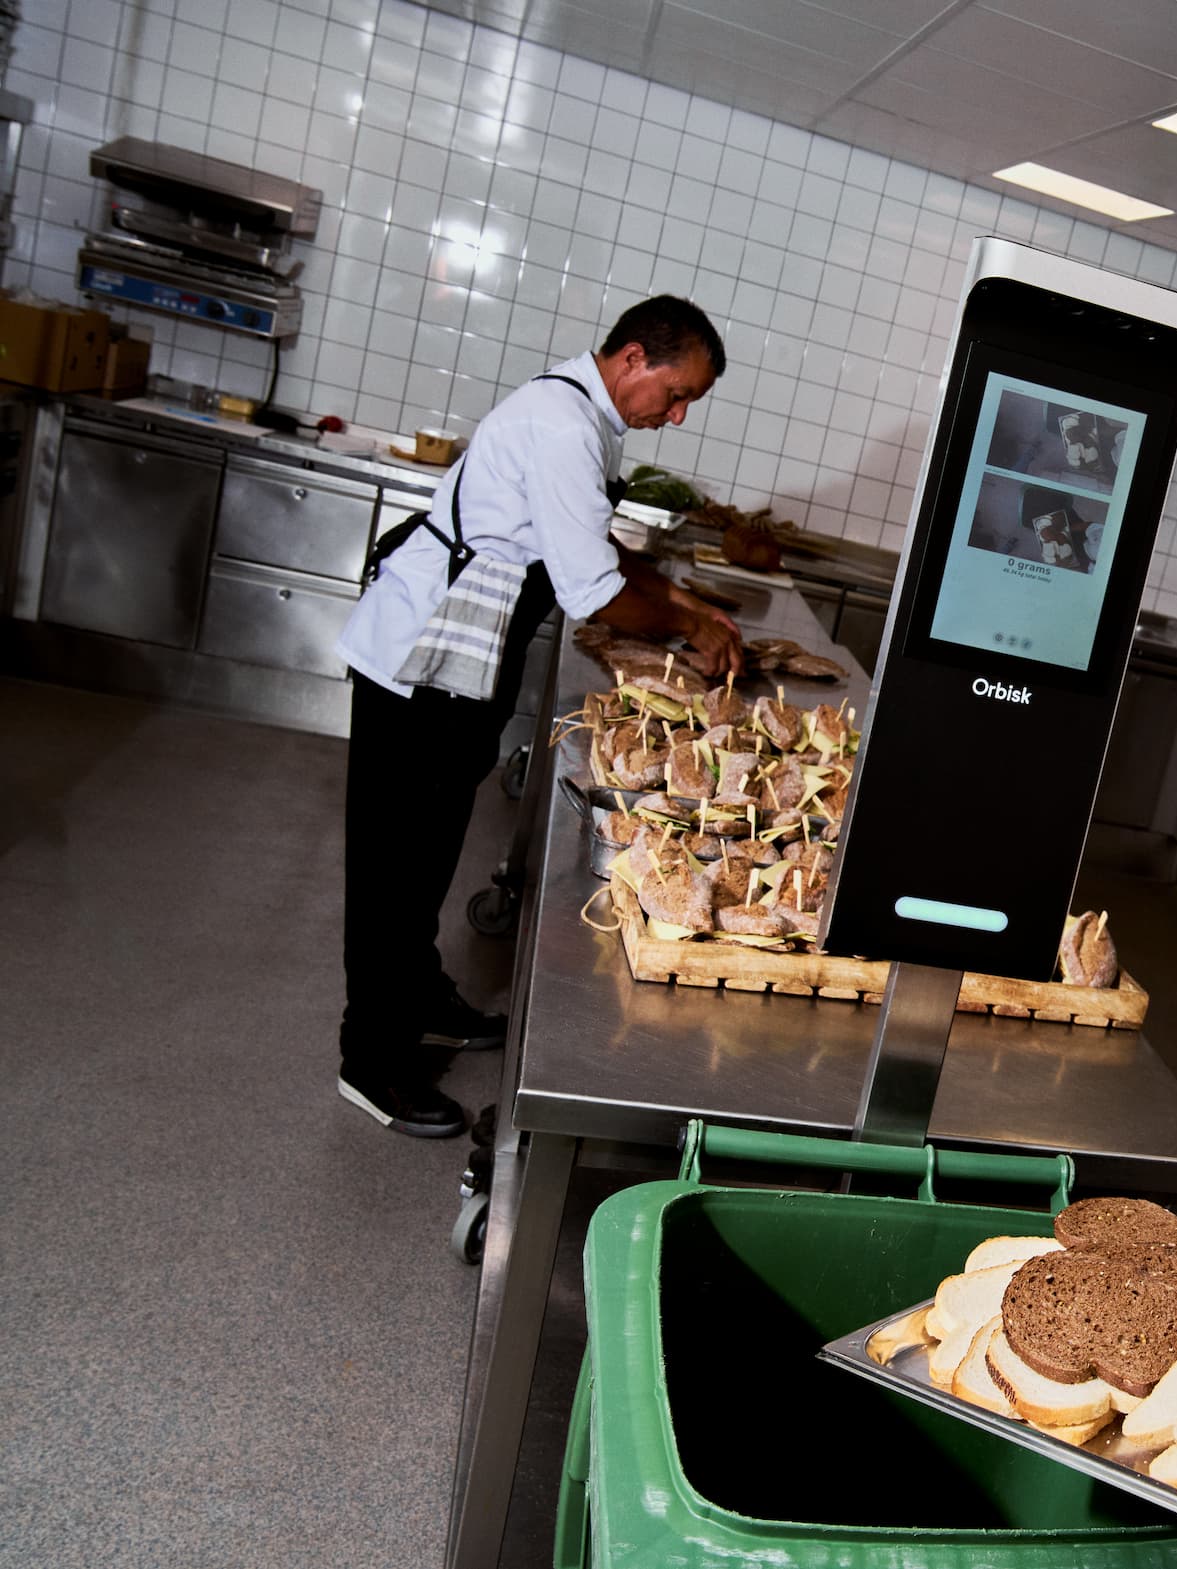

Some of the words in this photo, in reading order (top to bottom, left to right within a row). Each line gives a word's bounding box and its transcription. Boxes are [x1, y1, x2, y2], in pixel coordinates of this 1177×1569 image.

[1008, 558, 1015, 566] 0
[1017, 562, 1051, 575] grams
[972, 678, 1032, 704] Orbisk
